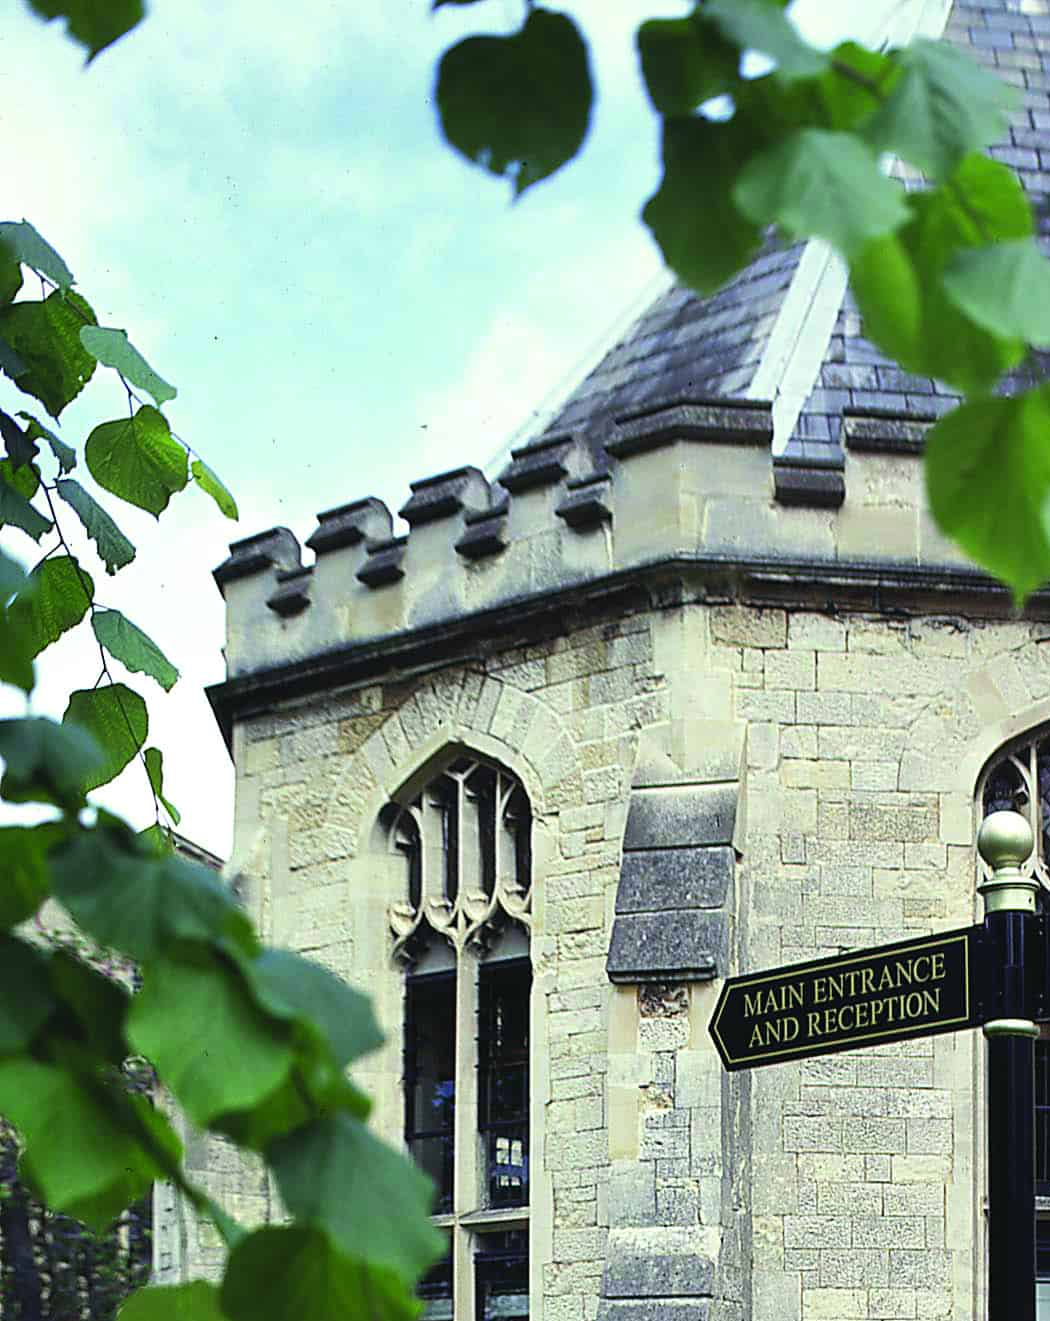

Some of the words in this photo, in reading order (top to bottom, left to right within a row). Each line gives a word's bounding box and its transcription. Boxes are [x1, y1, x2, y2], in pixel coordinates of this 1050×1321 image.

[743, 982, 805, 1018] MAIN
[813, 953, 946, 1004] ENTRANCE
[748, 1016, 800, 1049] AND
[807, 988, 940, 1038] RECEPTION
